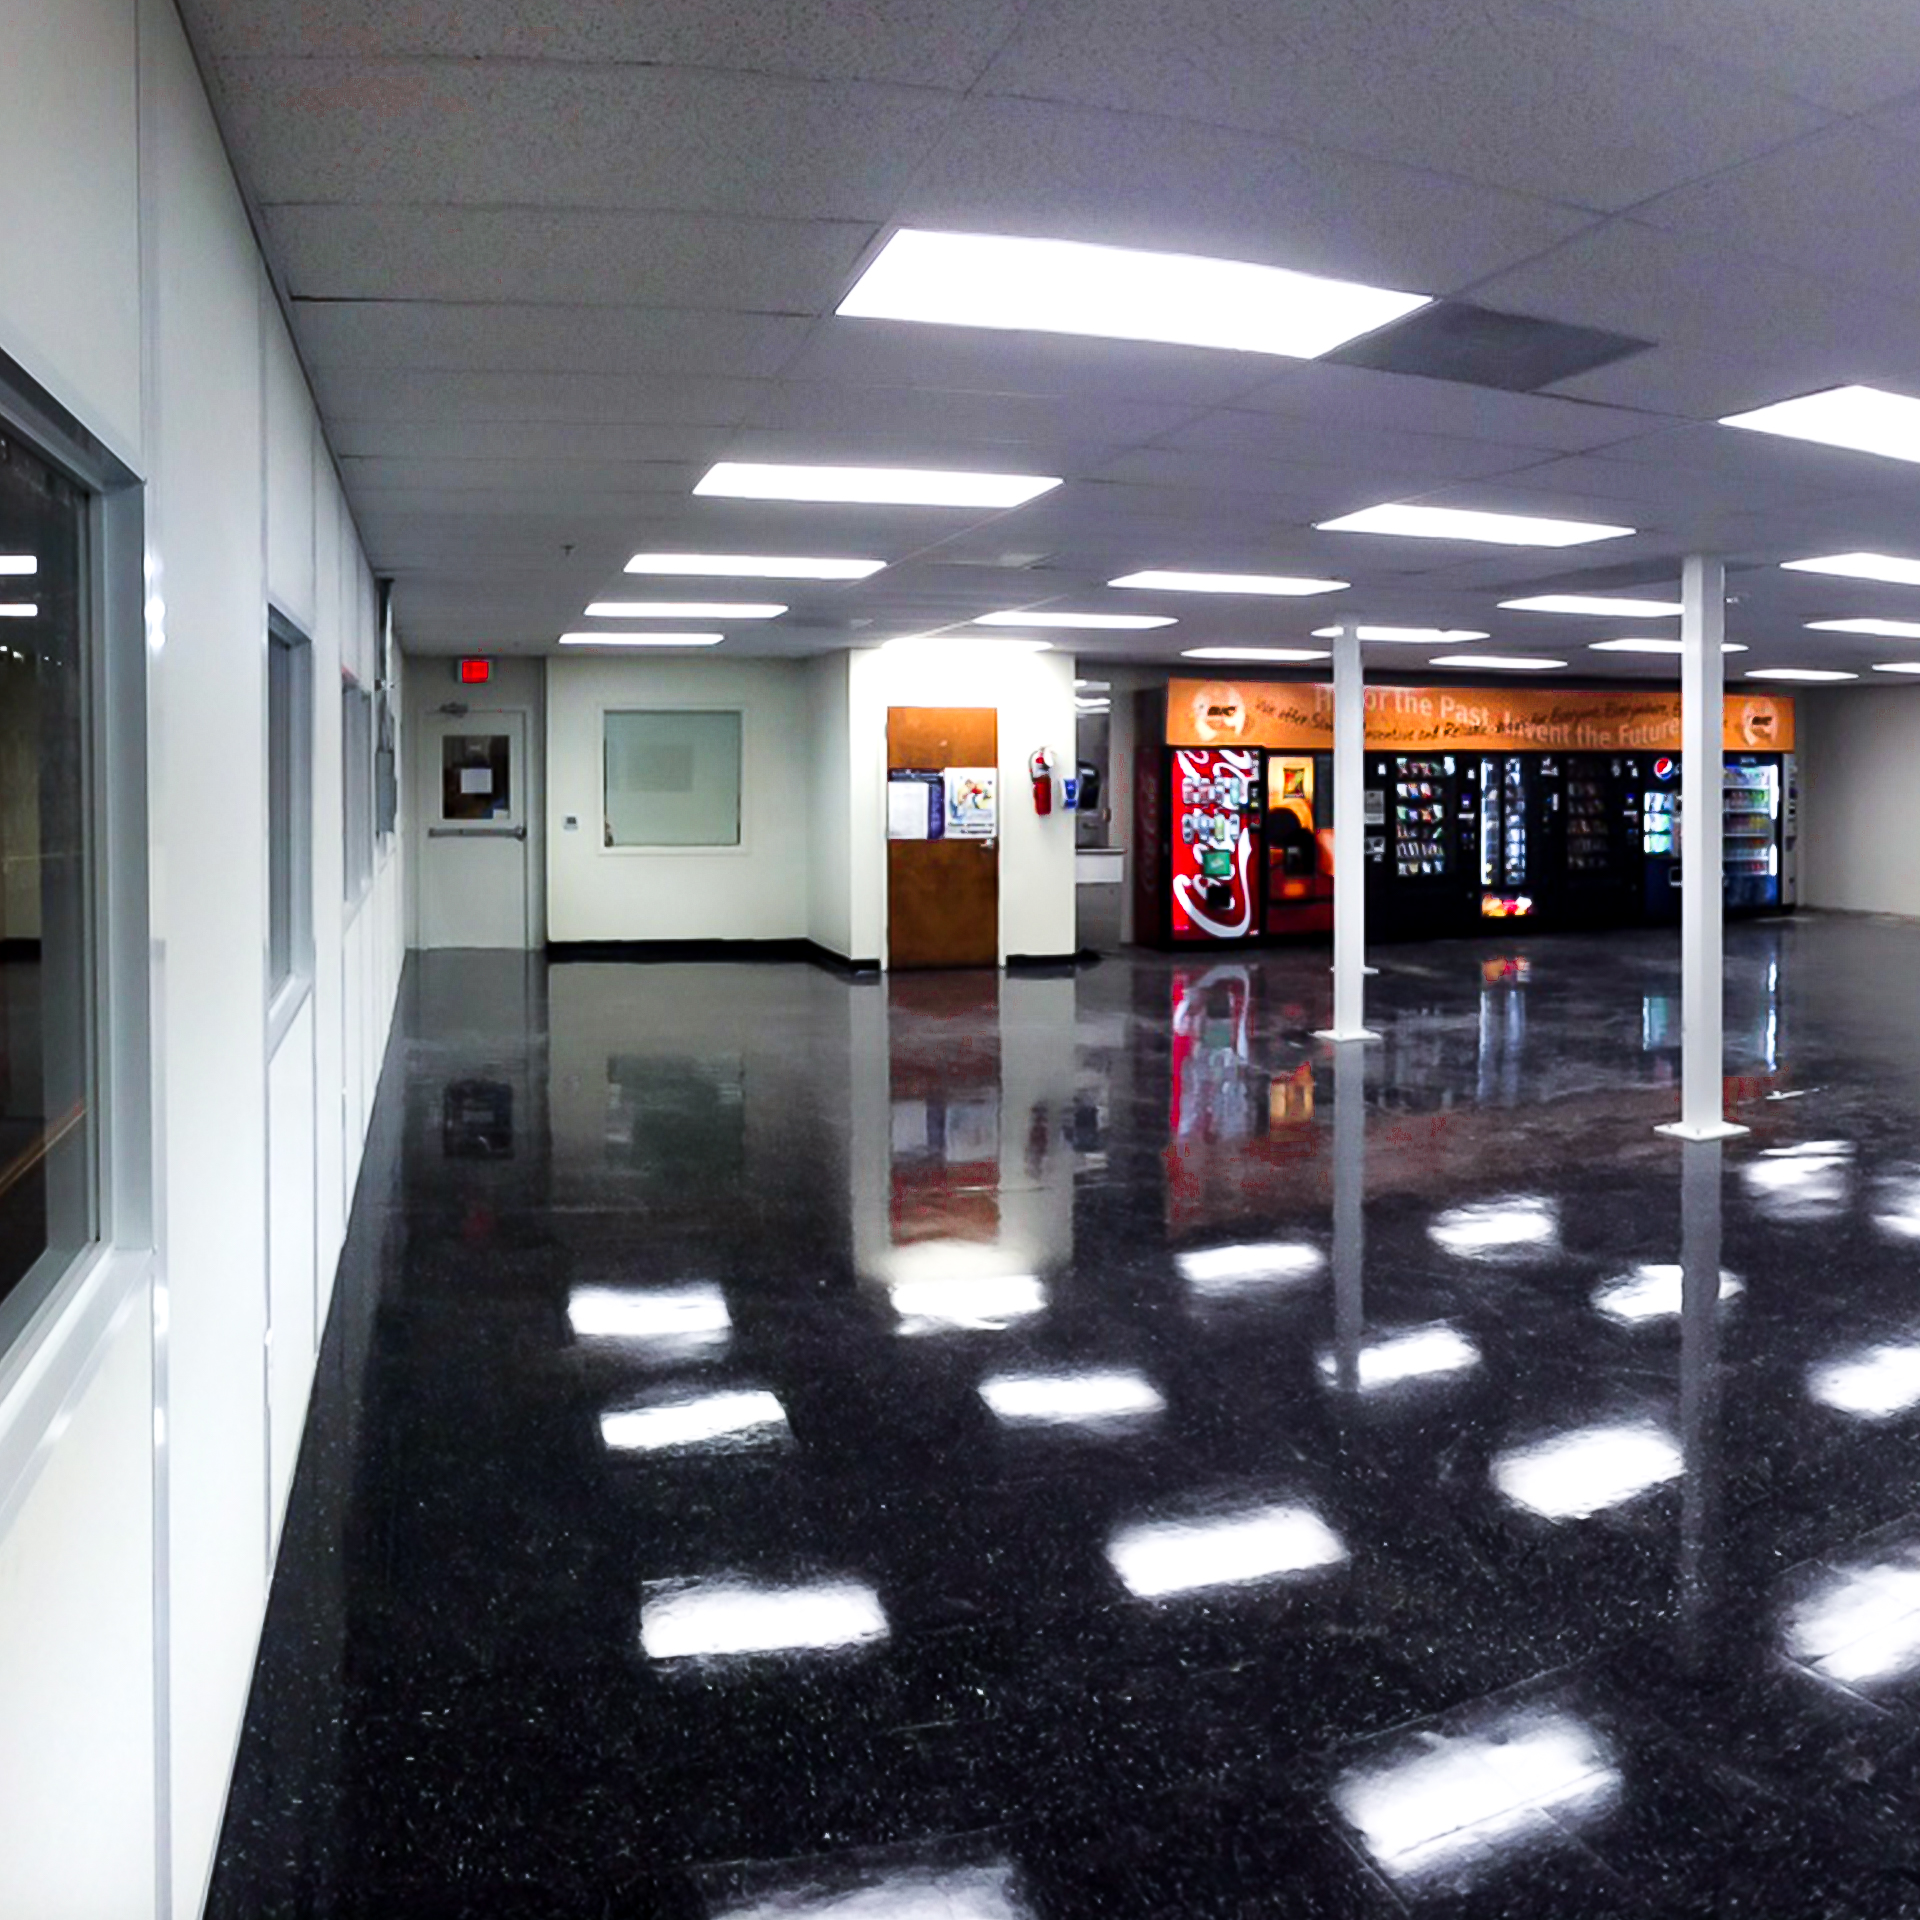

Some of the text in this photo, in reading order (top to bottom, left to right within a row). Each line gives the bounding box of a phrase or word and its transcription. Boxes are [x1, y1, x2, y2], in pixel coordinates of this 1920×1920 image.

[1315, 688, 1386, 711] Hor
[1395, 690, 1433, 717] the
[1577, 723, 1611, 748] the
[1618, 717, 1680, 746] Future
